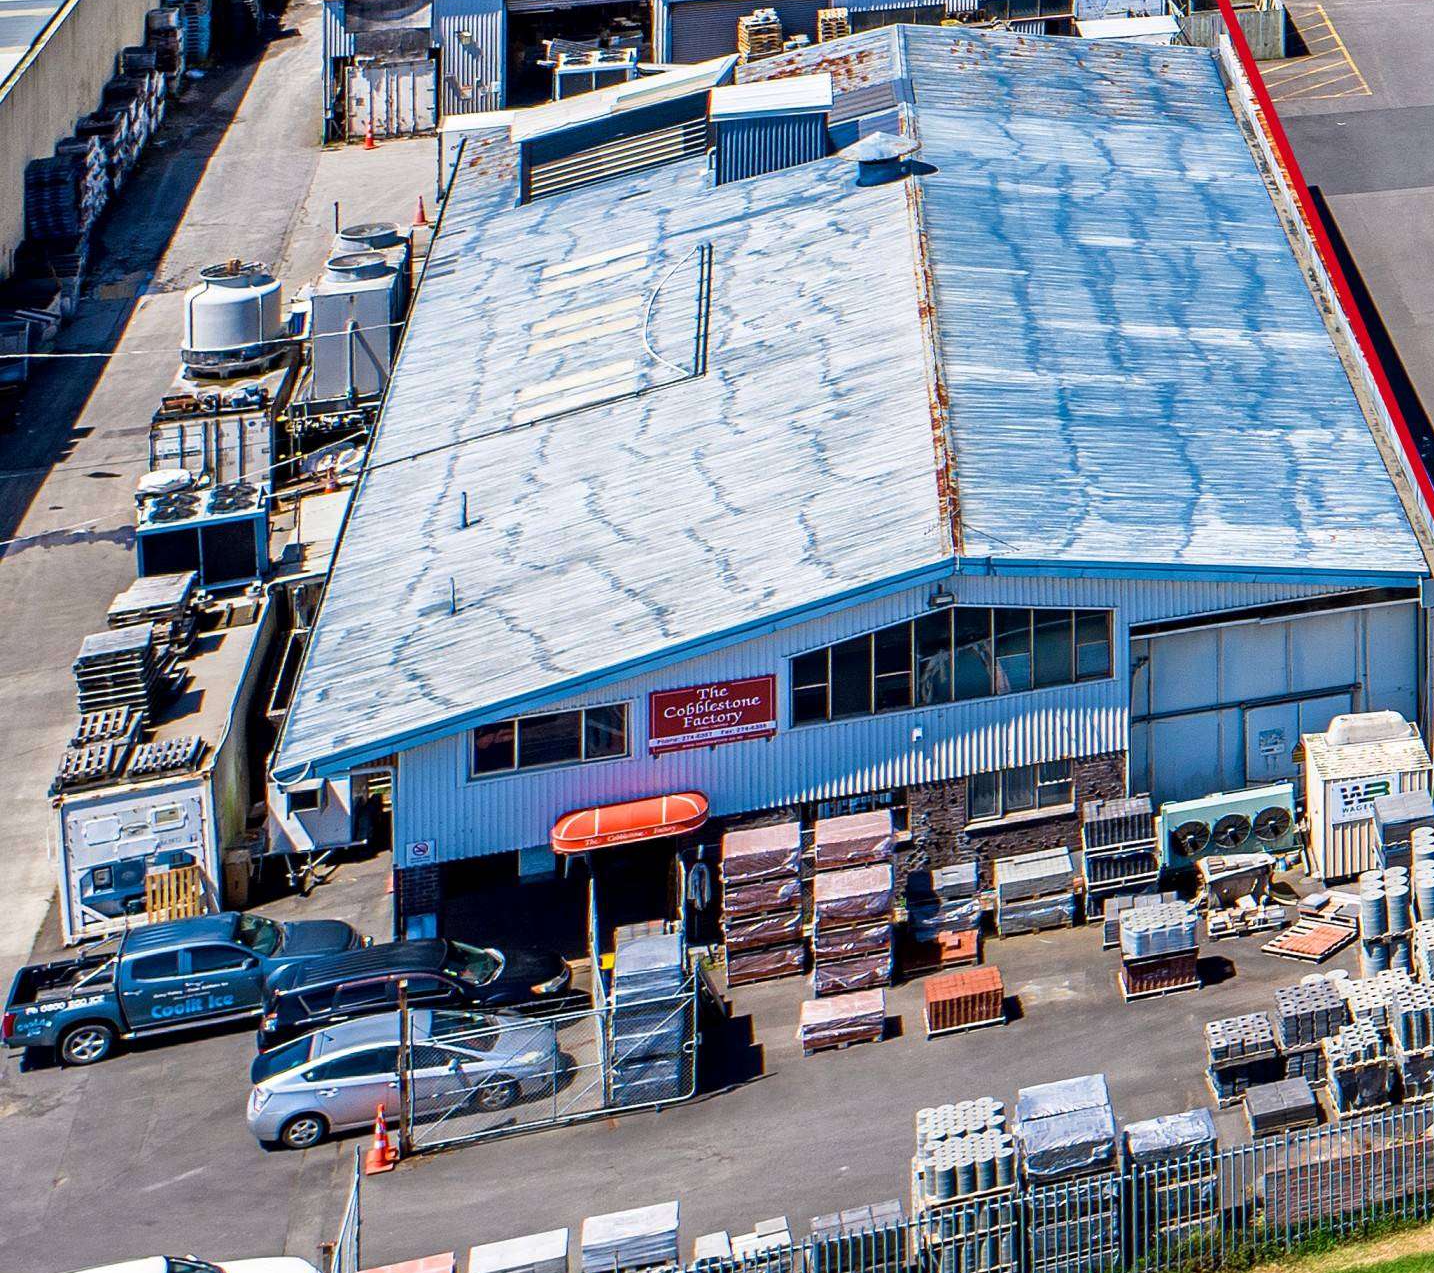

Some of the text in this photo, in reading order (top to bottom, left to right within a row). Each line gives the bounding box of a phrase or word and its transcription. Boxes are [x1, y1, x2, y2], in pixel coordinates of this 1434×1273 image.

[697, 686, 729, 700] The
[664, 696, 761, 719] Cobblestone
[683, 711, 742, 728] Factory
[1343, 803, 1375, 814] WAGEN
[208, 993, 235, 1008] Ice
